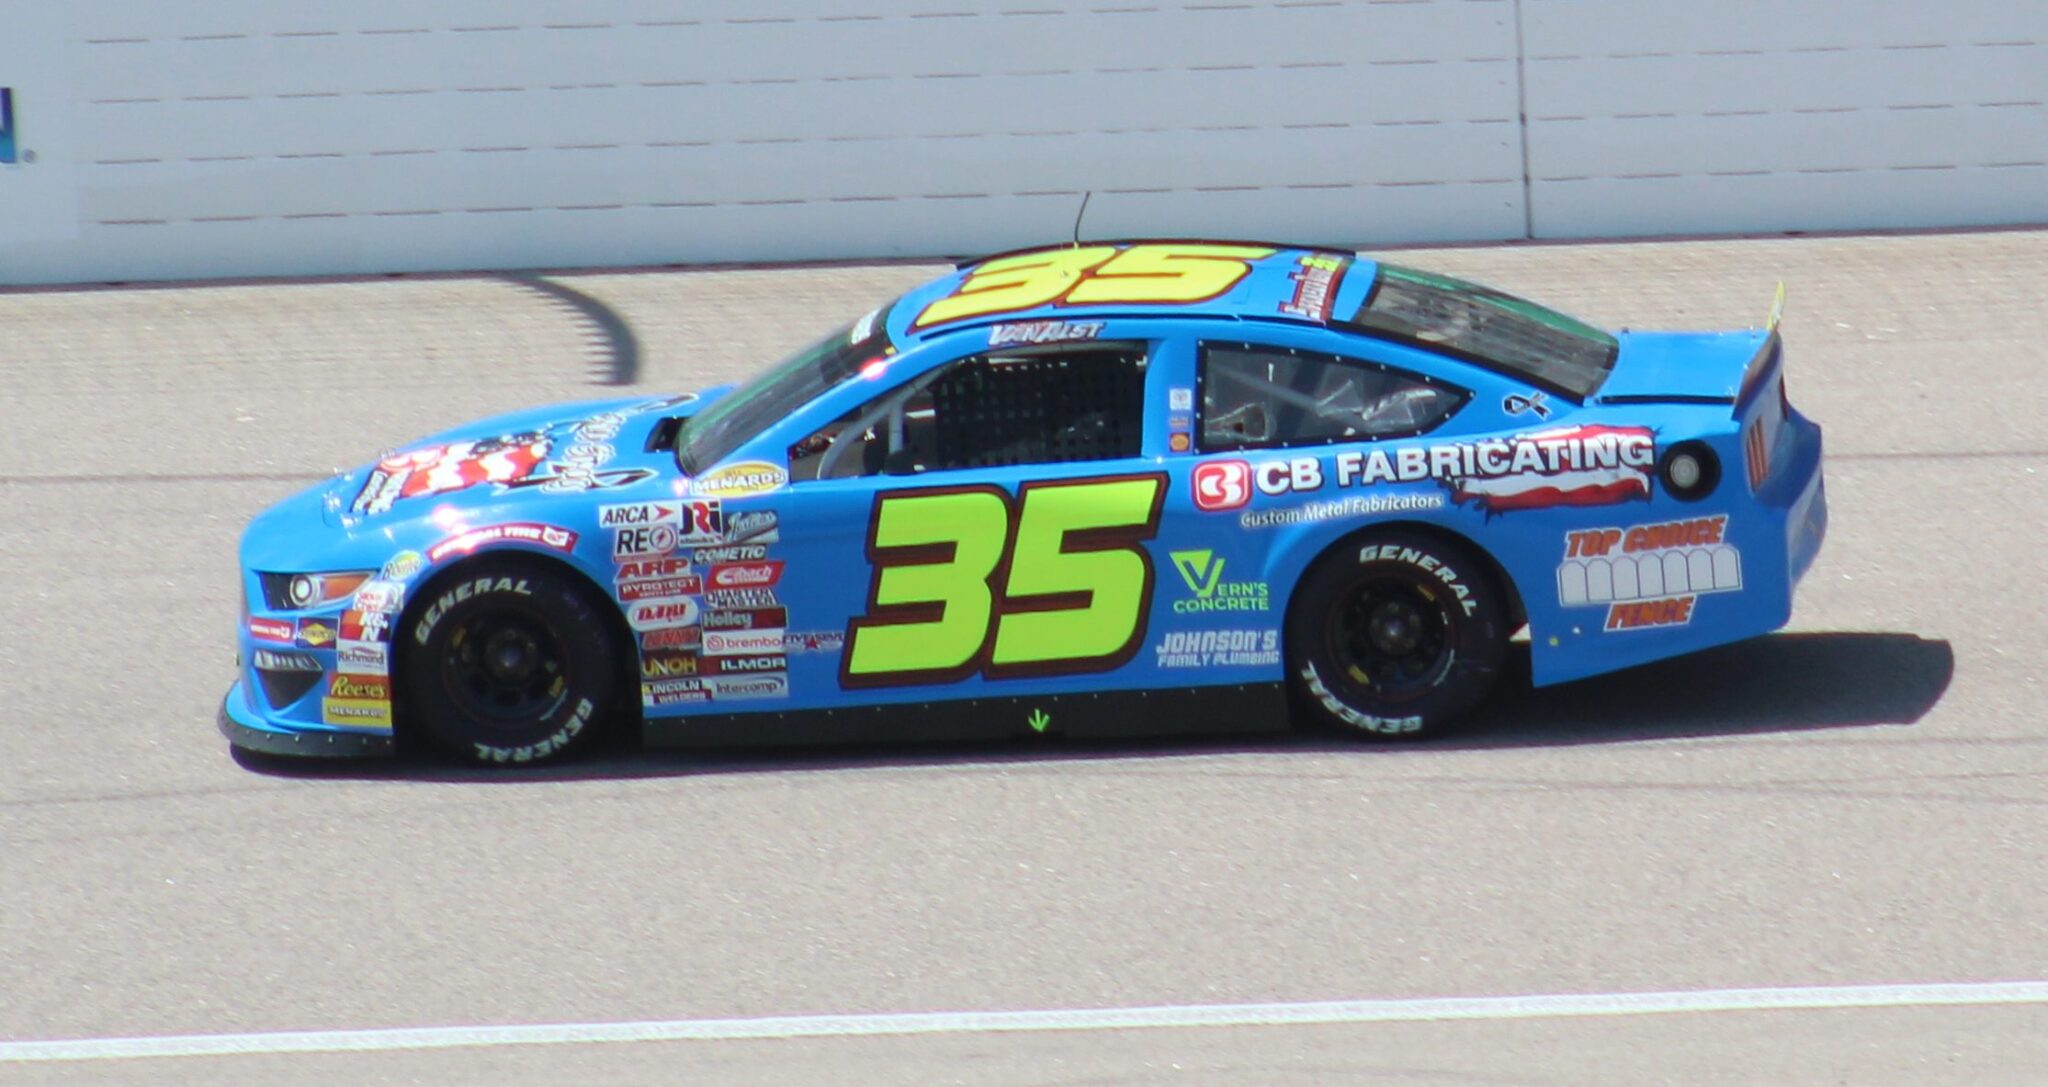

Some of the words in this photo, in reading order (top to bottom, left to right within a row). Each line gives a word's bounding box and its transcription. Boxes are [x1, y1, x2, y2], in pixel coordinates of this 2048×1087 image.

[914, 245, 1278, 329] 35
[1255, 458, 1322, 494] CB
[1337, 434, 1655, 487] FABRICATING
[692, 472, 785, 493] MENARDS
[602, 505, 650, 525] ARCA
[1240, 509, 1301, 529] Custom
[1303, 500, 1351, 521] Metal
[1352, 492, 1443, 515] Fabricators
[1567, 530, 1623, 558] TOP
[1622, 514, 1726, 553] CHOICE
[694, 545, 766, 564] COMETIC
[618, 559, 690, 578] ARP
[848, 479, 1160, 676] 35
[622, 579, 695, 593] PYROTECT
[1359, 545, 1477, 617] GENERAL
[415, 577, 532, 646] GENERAL
[1173, 597, 1269, 613] CONCRETE
[1606, 596, 1694, 630] FENCE
[703, 610, 752, 629] Holley
[726, 636, 783, 649] brembo
[1156, 630, 1277, 654] JOHNSON'S
[643, 657, 697, 677] UNOH
[721, 658, 786, 671] ILMOR
[1158, 653, 1210, 667] FAMILY
[1213, 651, 1279, 666] PLUMBING
[717, 682, 777, 694] Intercomp
[474, 698, 593, 762] GENERAL
